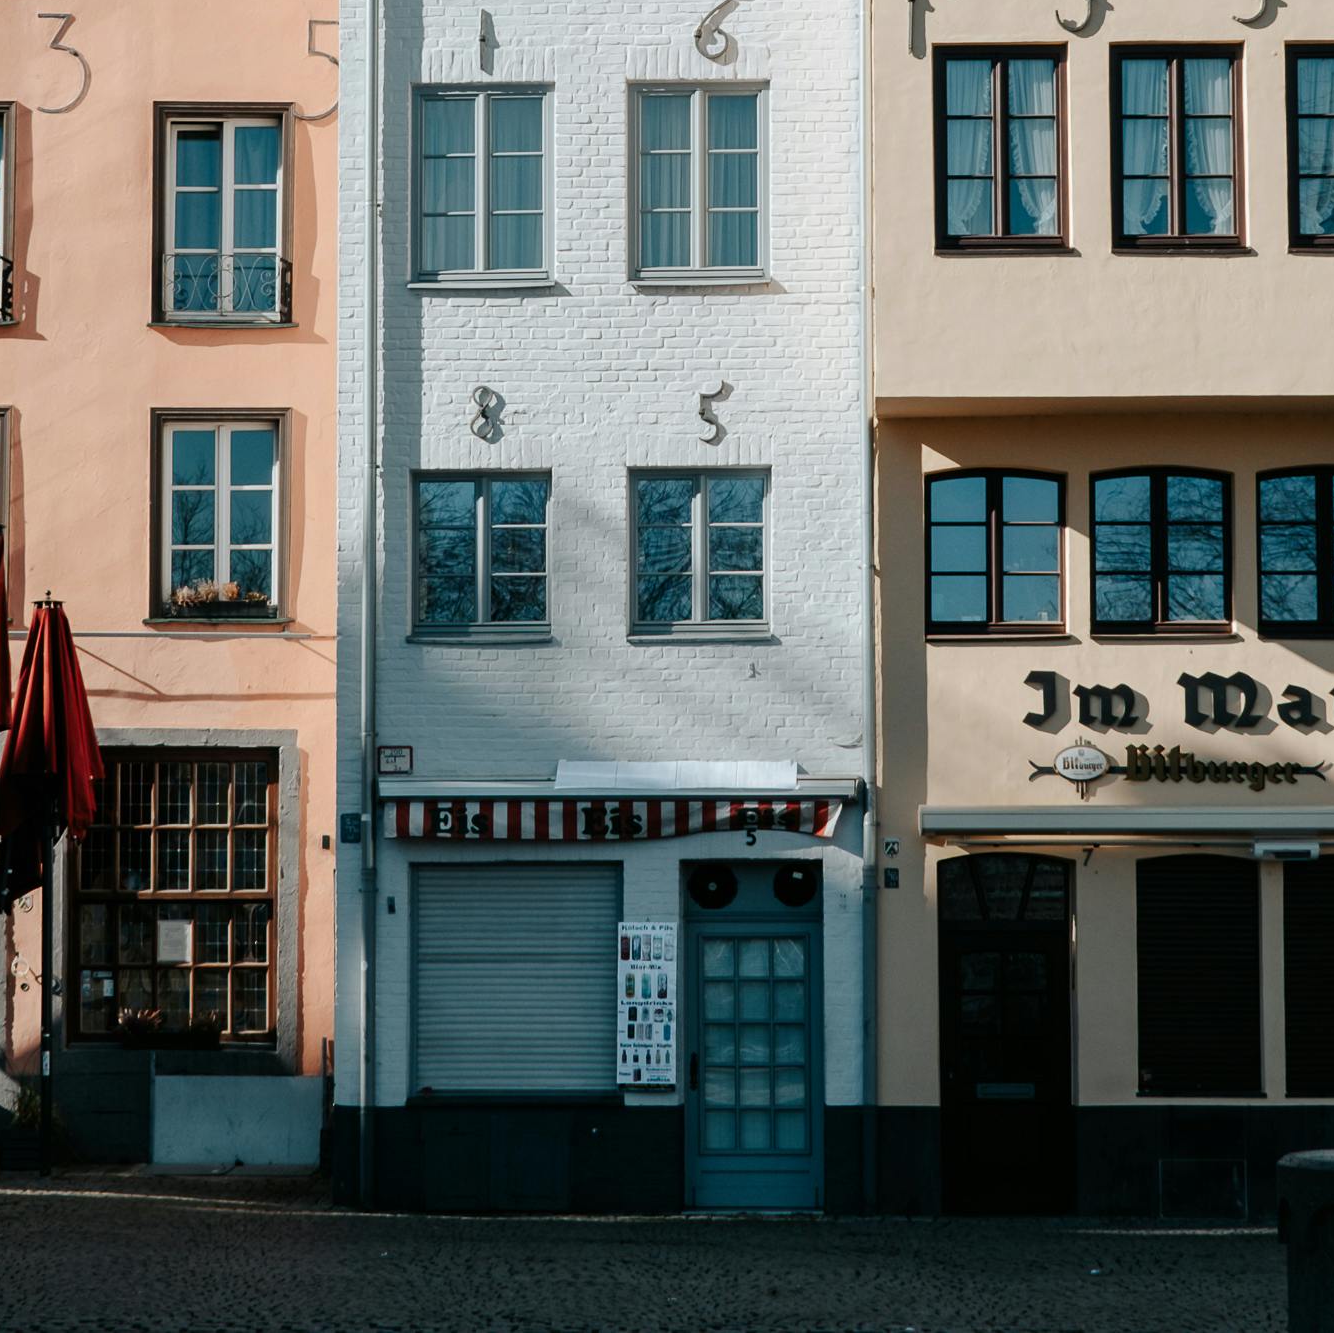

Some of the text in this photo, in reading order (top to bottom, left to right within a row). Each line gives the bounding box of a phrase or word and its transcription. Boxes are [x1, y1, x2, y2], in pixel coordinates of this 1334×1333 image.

[36, 13, 92, 115] 3
[295, 20, 340, 121] 5
[471, 380, 728, 444] 8 5
[1023, 670, 1138, 729] Im
[1063, 757, 1103, 771] Bitburger
[1123, 744, 1303, 791] Bitburger
[430, 807, 797, 834] Eis Eis Eis
[745, 828, 757, 846] 5
[1082, 847, 1094, 866] 7
